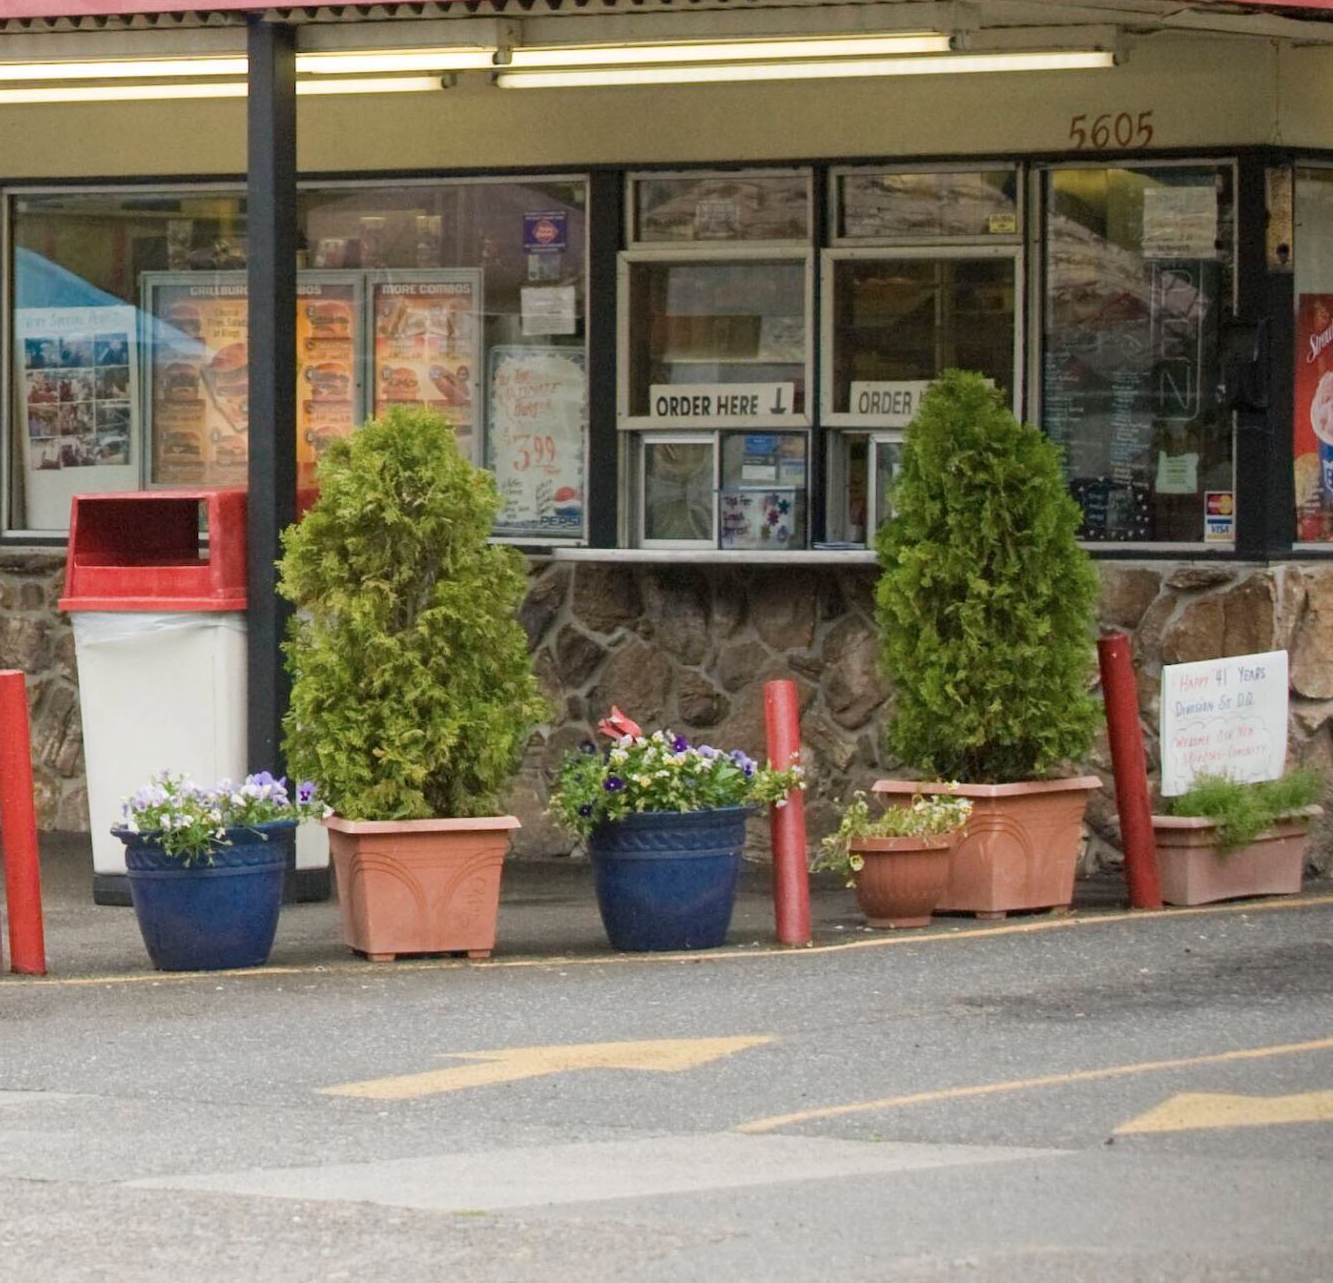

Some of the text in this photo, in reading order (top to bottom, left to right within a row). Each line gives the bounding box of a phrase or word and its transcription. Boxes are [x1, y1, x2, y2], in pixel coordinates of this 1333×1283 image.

[1069, 110, 1153, 148] 5605
[382, 284, 470, 294] MORE COMBOS
[656, 394, 758, 416] ORDER HERE
[858, 391, 912, 414] ORDER
[539, 516, 579, 527] PEPSI
[1179, 666, 1267, 692] HAPPY 41 YEARS
